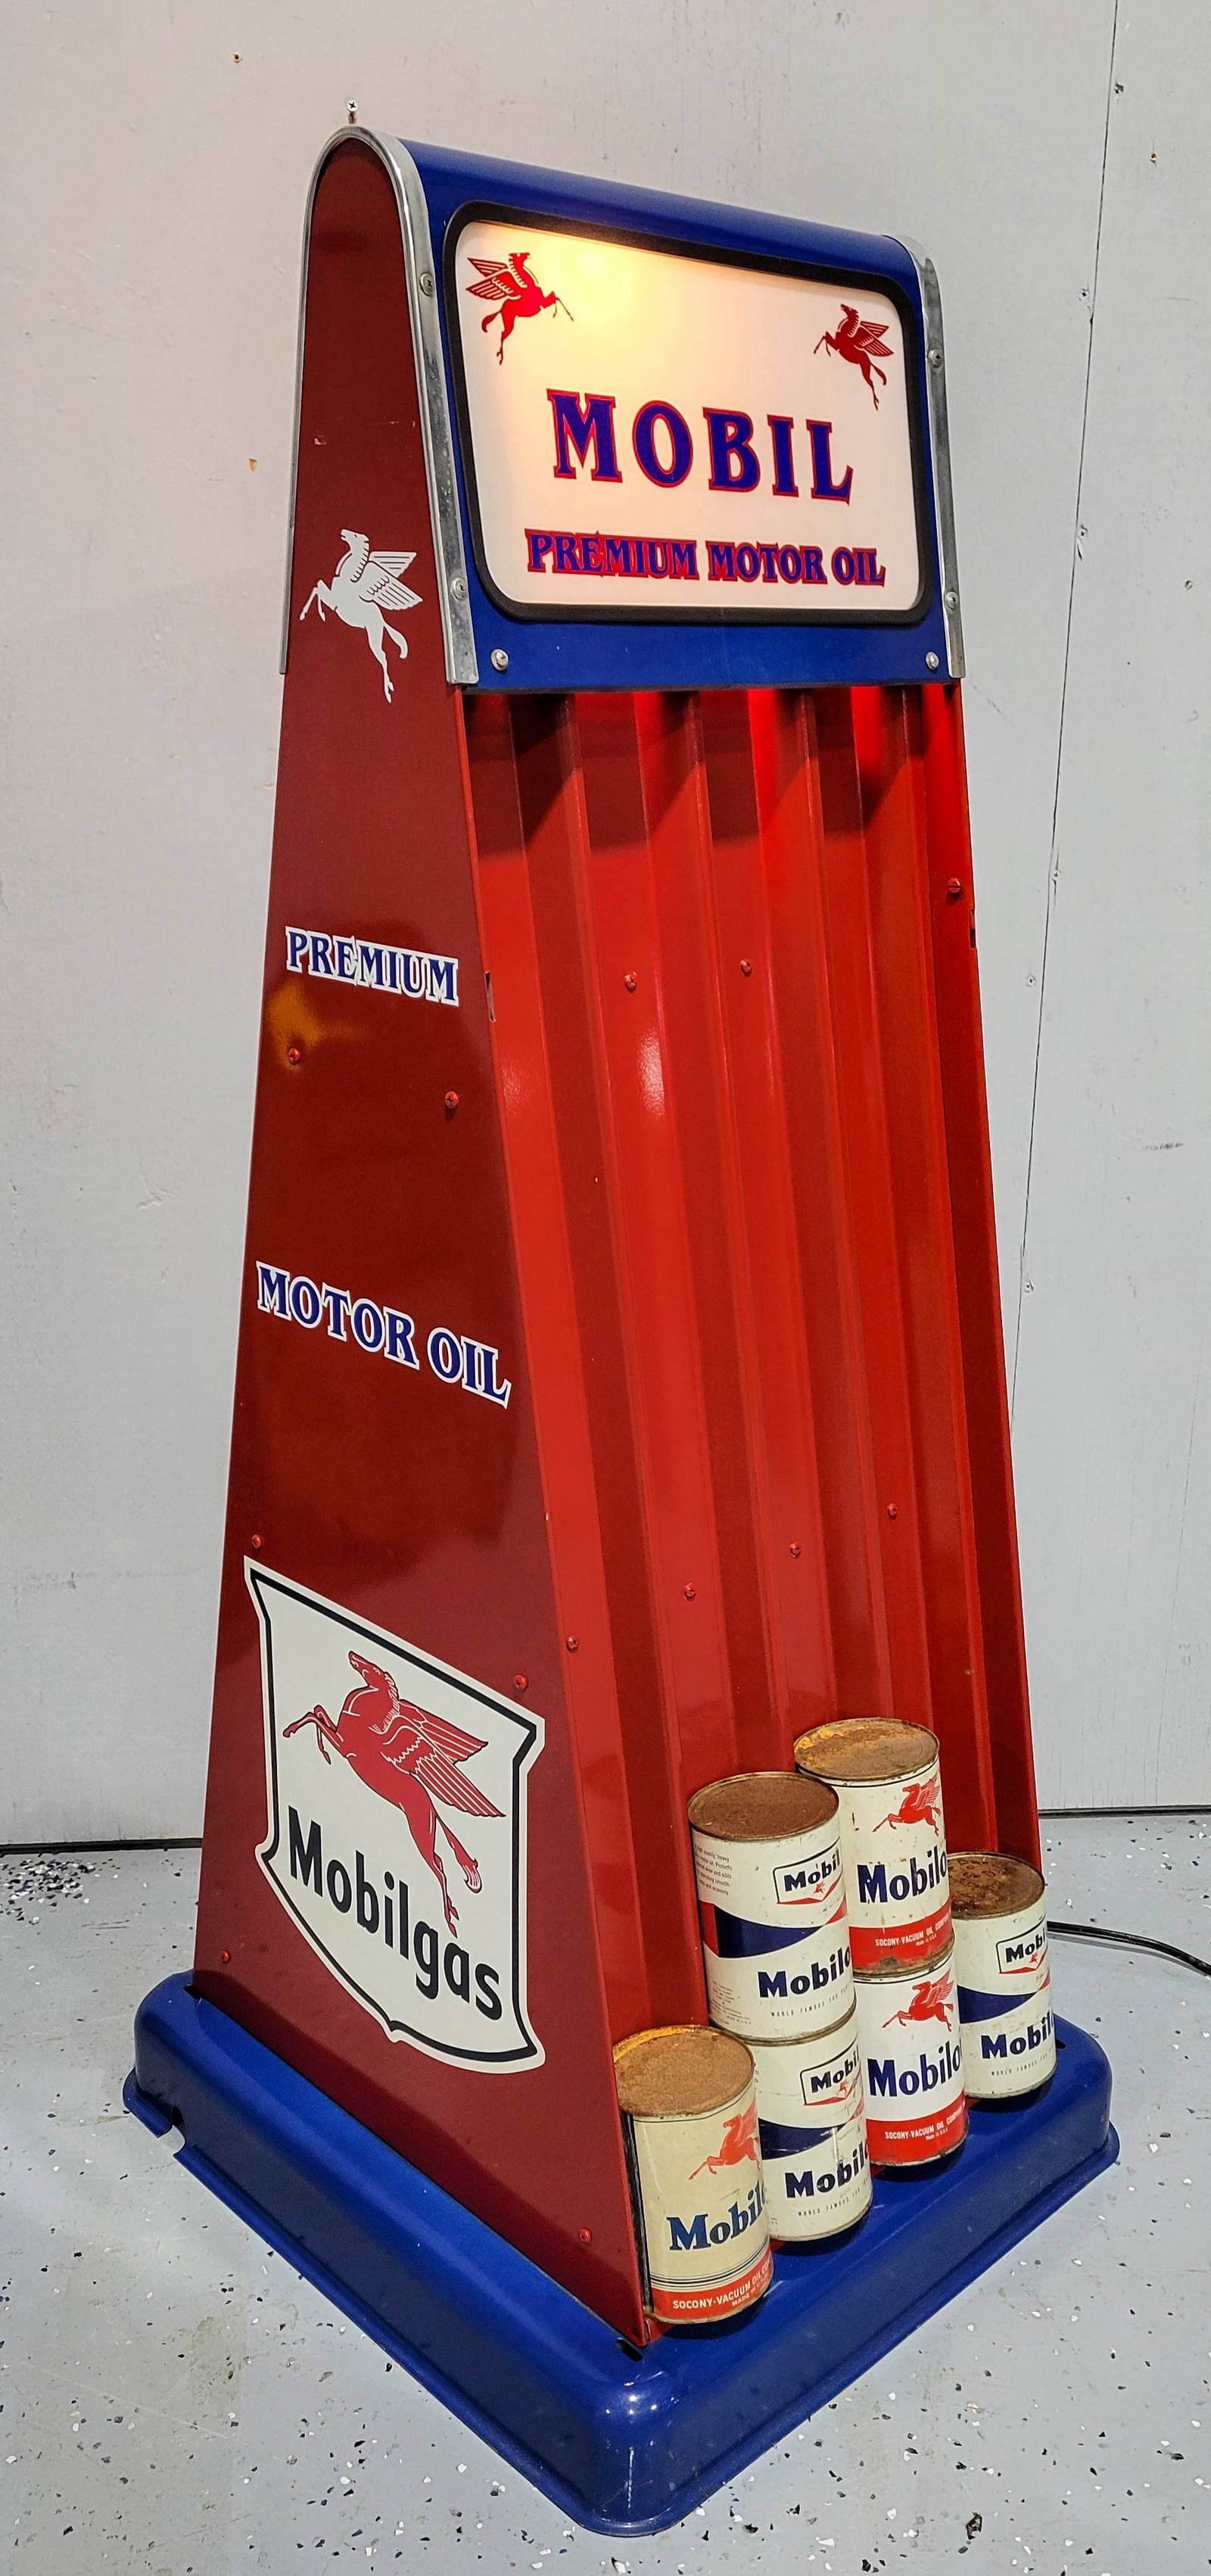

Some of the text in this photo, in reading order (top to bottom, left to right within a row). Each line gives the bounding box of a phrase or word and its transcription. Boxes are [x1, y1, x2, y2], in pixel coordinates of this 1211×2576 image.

[546, 388, 854, 504] MOBIL
[525, 528, 886, 587] PREMIUM MOTOR OIL
[286, 927, 459, 1005] PREMIUM
[257, 1261, 511, 1408] MOTOR OIL
[784, 1848, 840, 1892] Mobil
[857, 1845, 947, 1903] Mobilo
[288, 1805, 503, 2021] Mobilgas
[811, 2045, 859, 2094] Mobil
[673, 2281, 751, 2310] SOCONY-VACUUM
[752, 2270, 761, 2285] OIL
[732, 2294, 750, 2307] MADE
